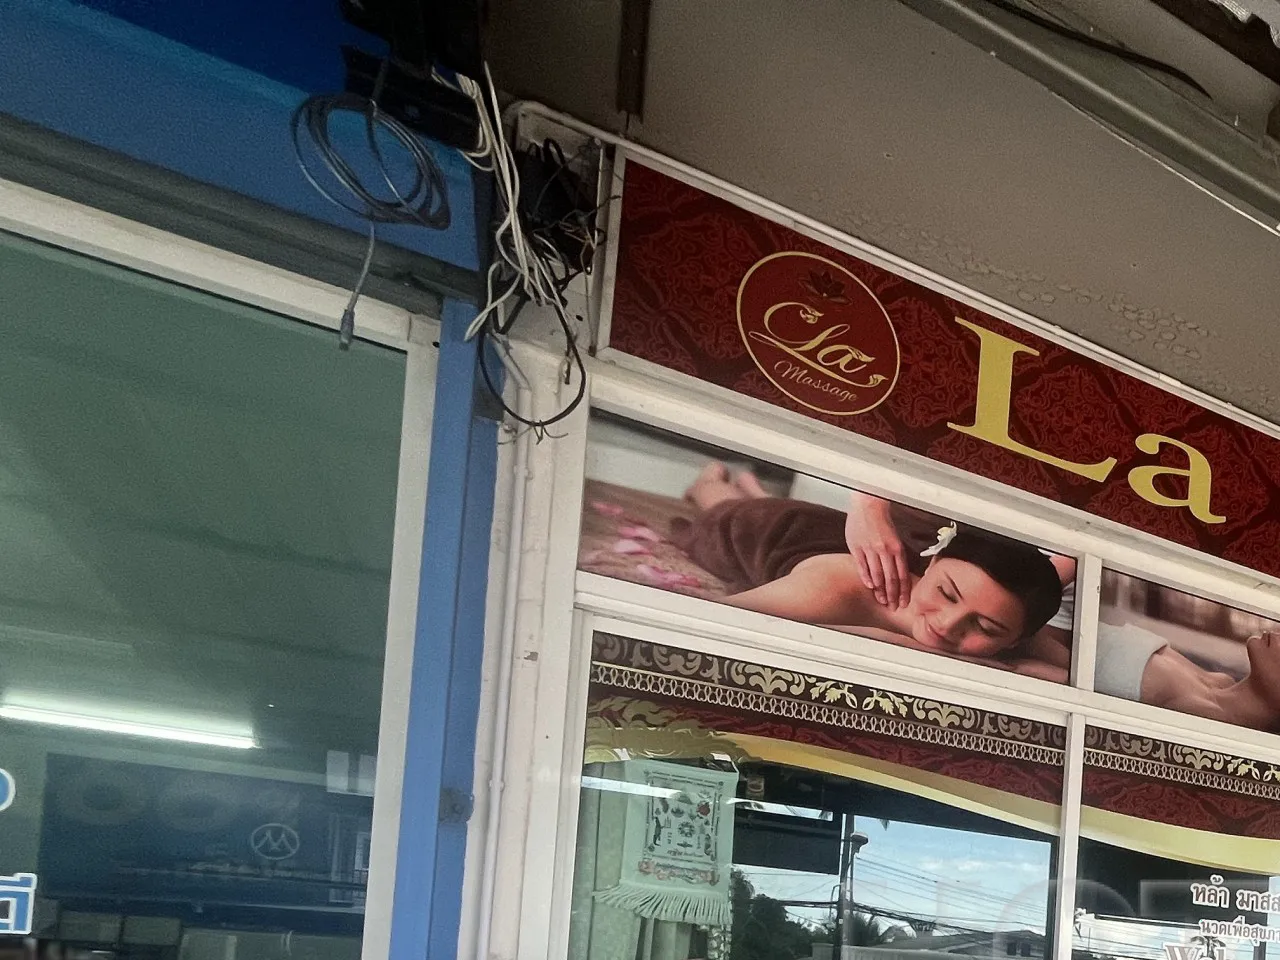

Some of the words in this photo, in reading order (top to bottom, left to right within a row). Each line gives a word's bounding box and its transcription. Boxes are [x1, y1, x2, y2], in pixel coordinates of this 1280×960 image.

[749, 302, 888, 388] La
[774, 361, 857, 401] Massage
[947, 316, 1227, 524] La
